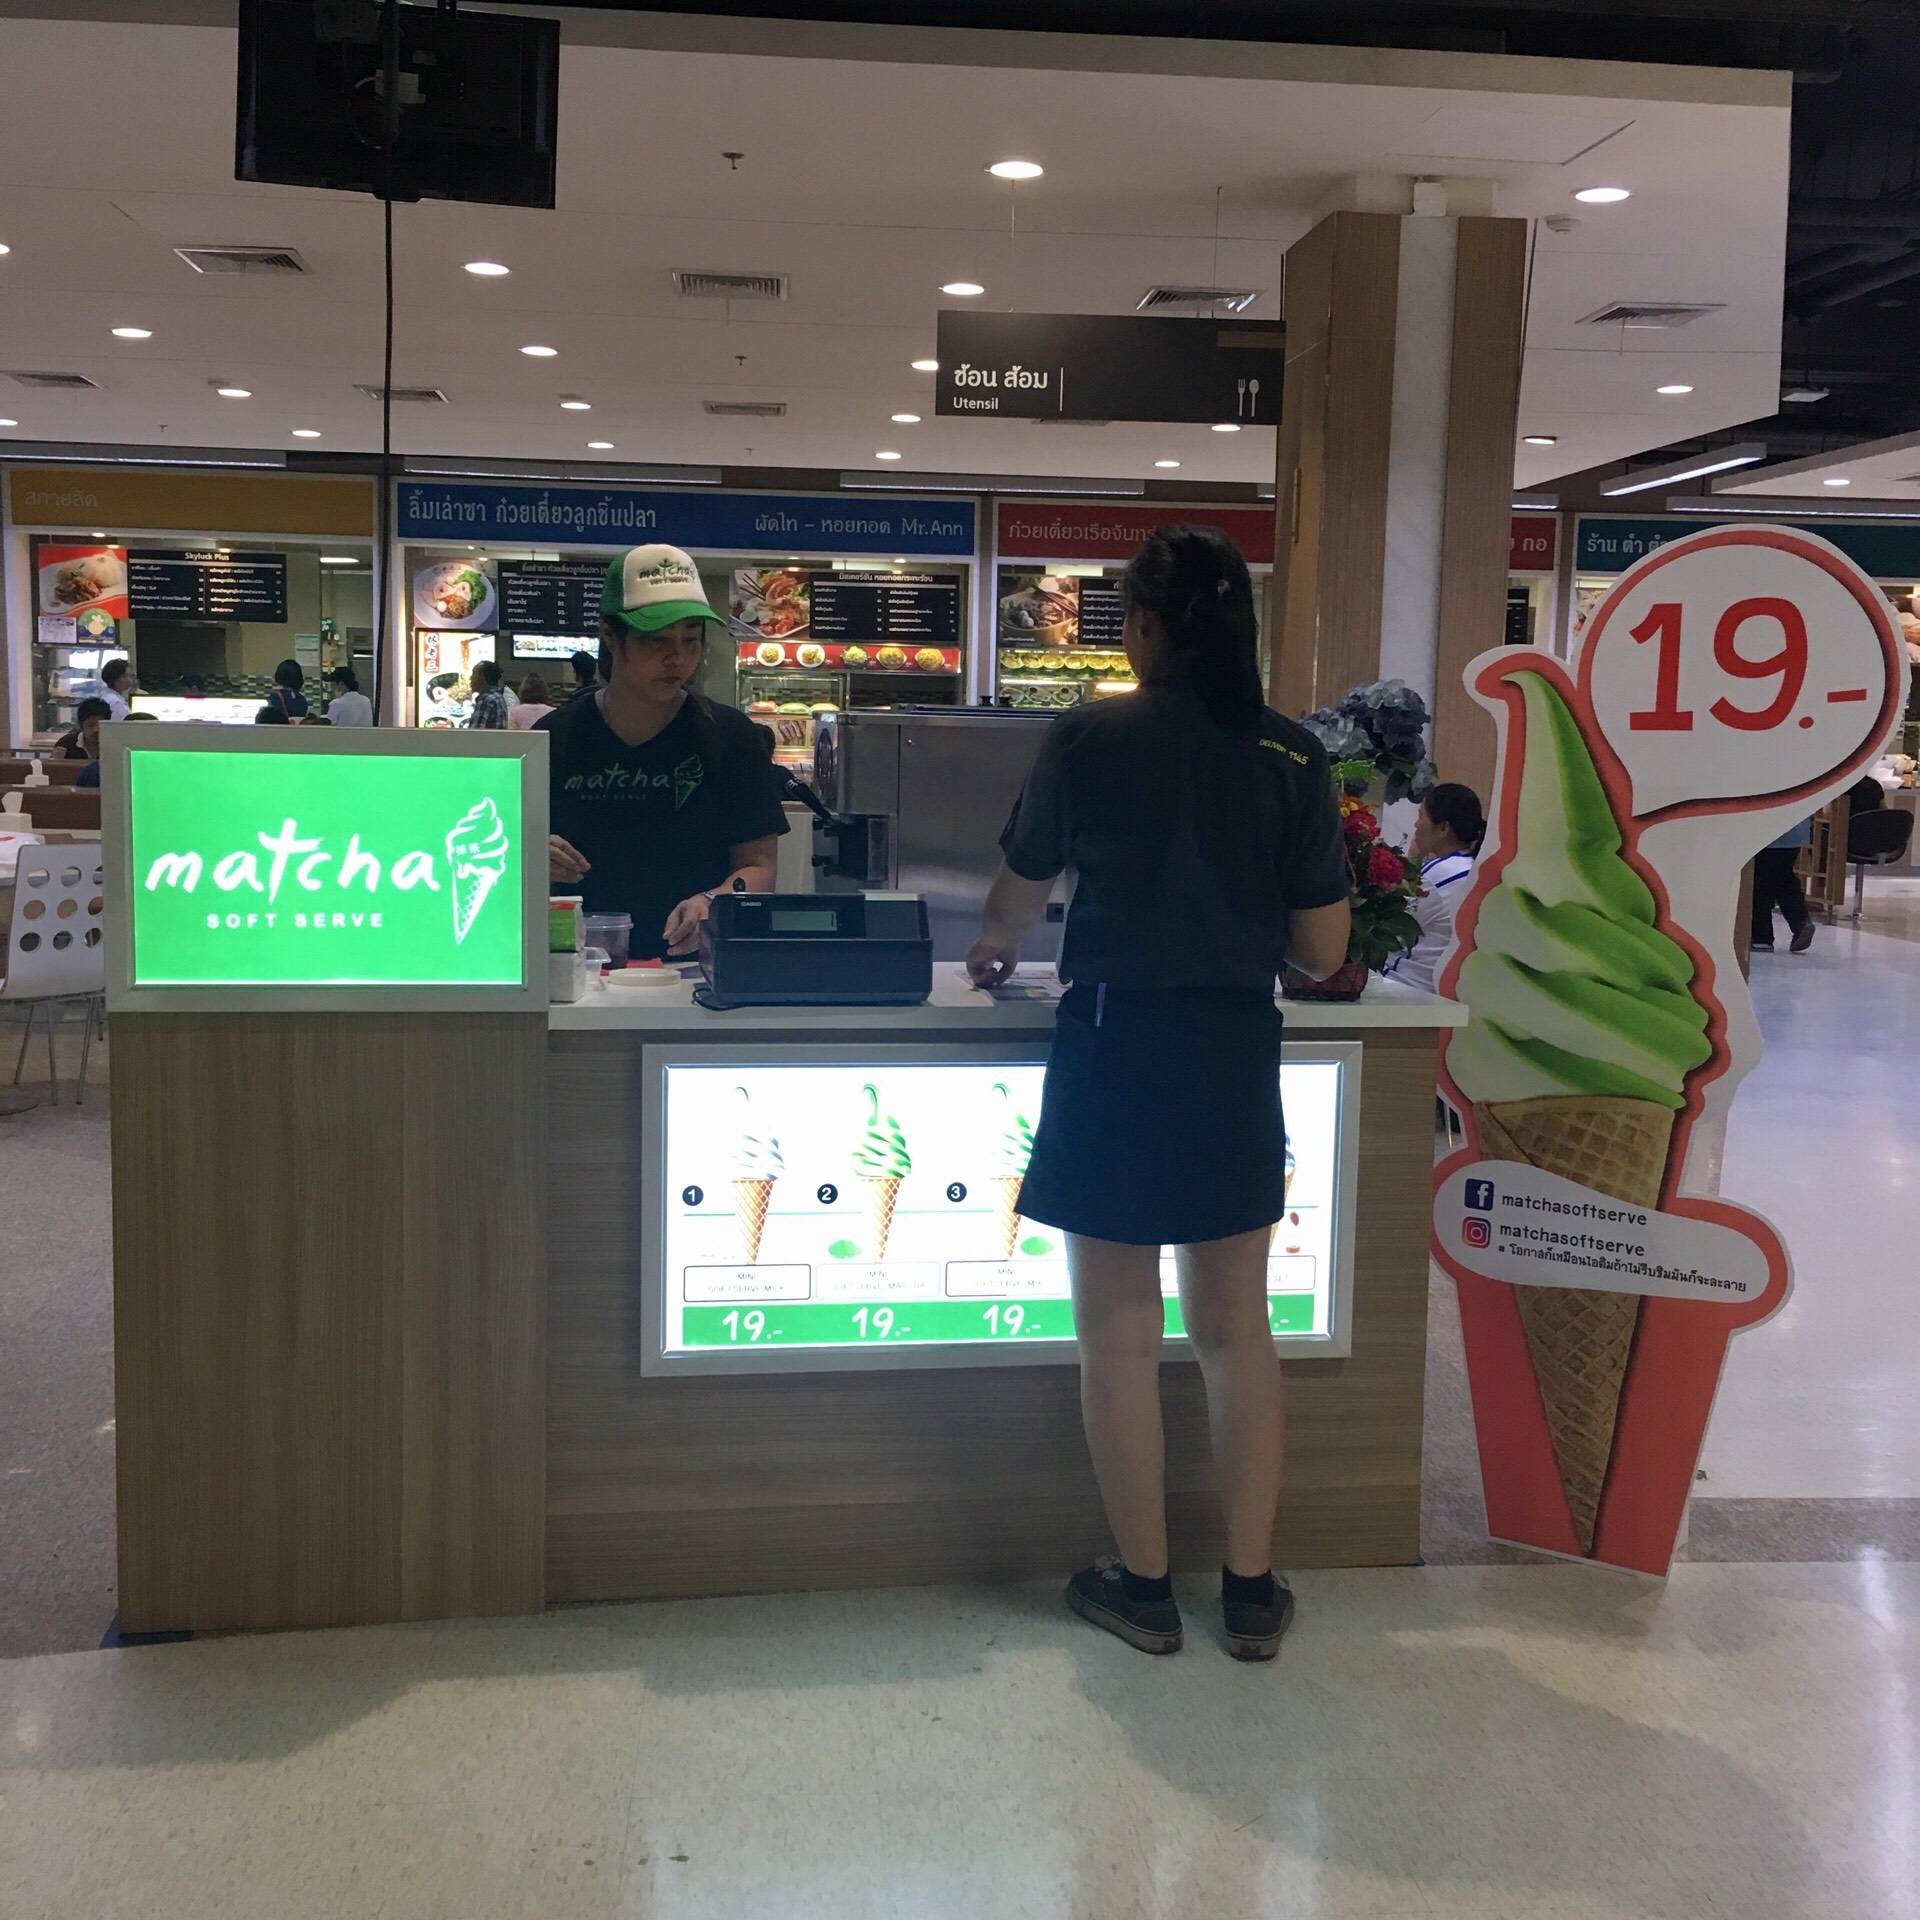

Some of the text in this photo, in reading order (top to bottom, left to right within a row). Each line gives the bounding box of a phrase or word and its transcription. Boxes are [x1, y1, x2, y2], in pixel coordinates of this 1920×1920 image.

[953, 363, 1048, 389] ช้อน ส้อม
[953, 396, 999, 410] Utensil
[408, 489, 657, 533] ลิ้มเล่าซา ก๋วยเตี๋ยวลูกชิ้นปลา
[754, 511, 798, 533] ผัดไท
[820, 518, 892, 535] หอยทอด
[900, 517, 964, 537] Mr.Ann
[214, 553, 230, 561] Plus
[1586, 532, 1617, 553] ร้าน
[1628, 596, 1868, 732] 19.-
[564, 762, 671, 791] matcha
[145, 817, 441, 905] matcha
[206, 912, 384, 928] SOFT SERVE
[1501, 1193, 1648, 1227] matchasoftserve
[1499, 1222, 1646, 1257] matchasoftserve
[721, 1309, 784, 1342] 19.-
[850, 1307, 912, 1339] 19.-
[981, 1304, 1043, 1336] 19.-
